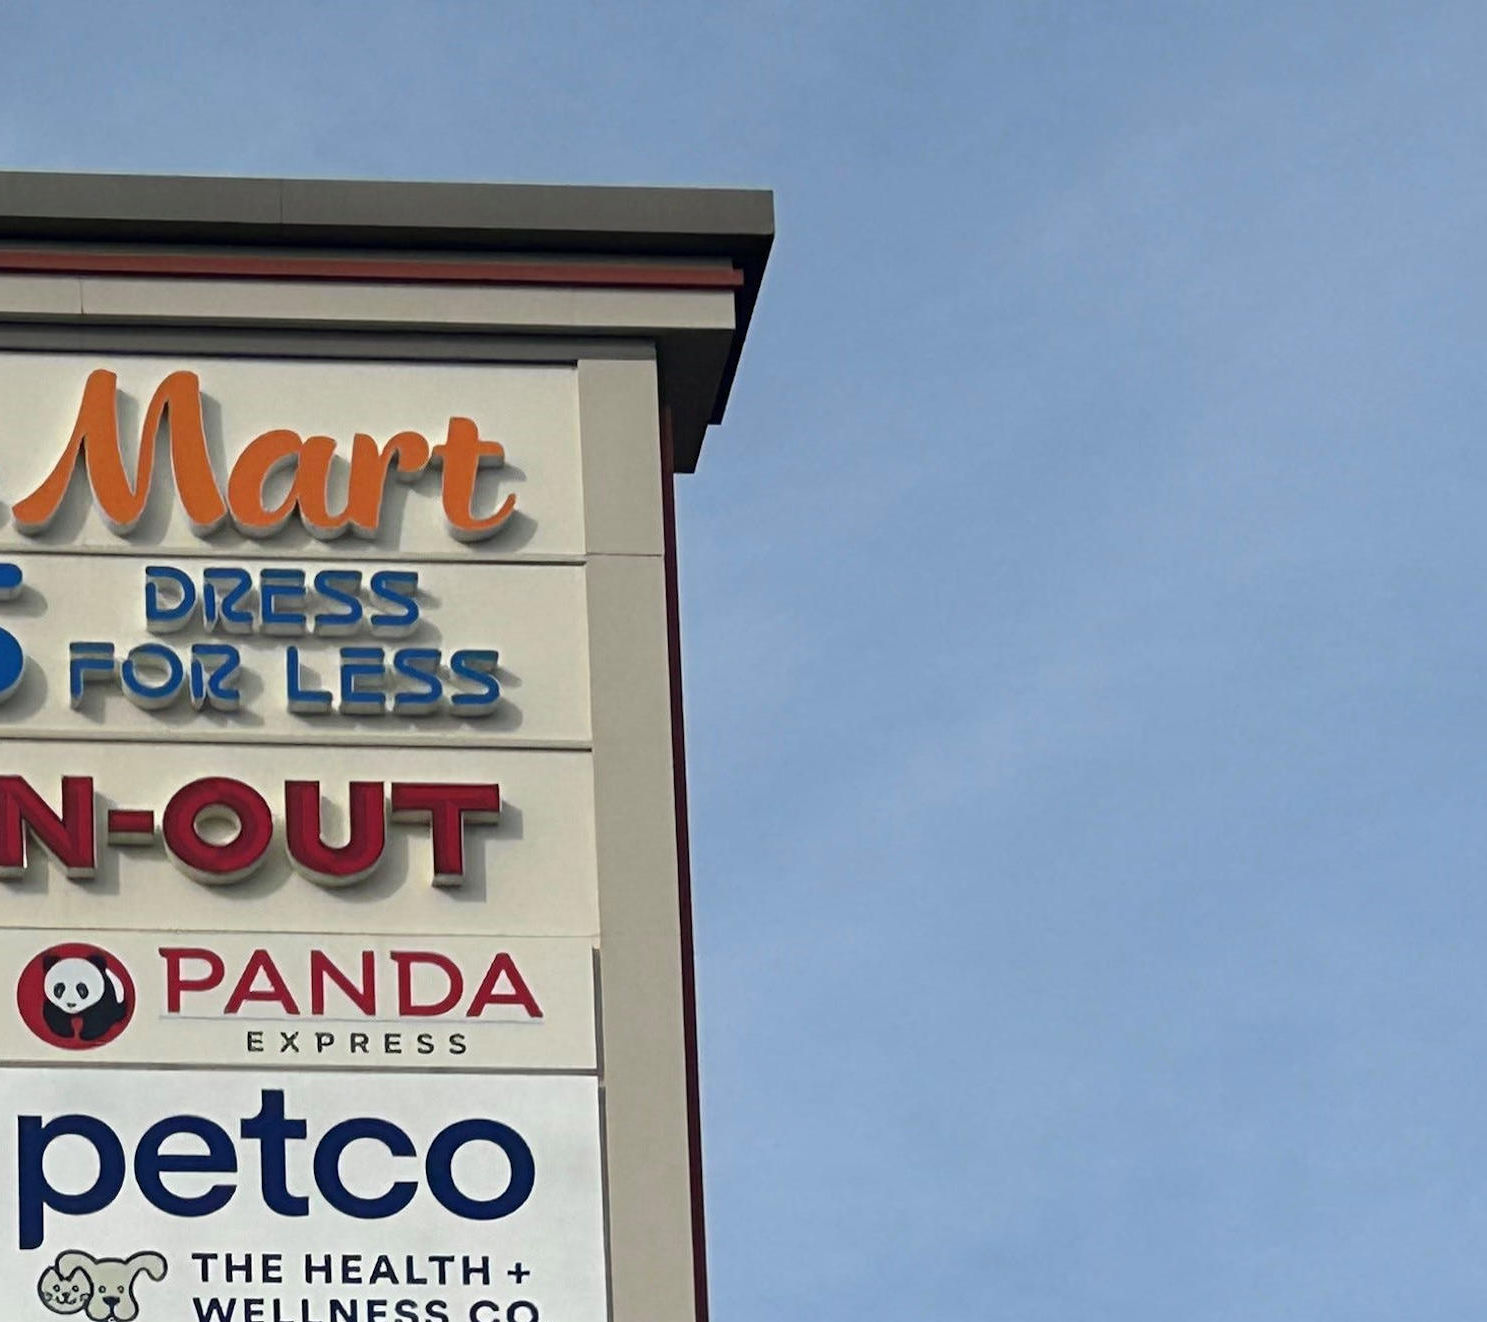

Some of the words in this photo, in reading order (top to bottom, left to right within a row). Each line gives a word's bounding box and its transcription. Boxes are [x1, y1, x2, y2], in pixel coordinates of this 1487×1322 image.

[13, 368, 519, 545] Mart
[145, 565, 419, 637] DRESS
[69, 641, 241, 709] FOR
[286, 645, 501, 713] LESS
[158, 946, 544, 1019] PANDA
[246, 1030, 468, 1056] EXPRESS
[17, 1089, 536, 1250] petco
[191, 1252, 285, 1284] THE
[305, 1254, 492, 1287] HEALTH
